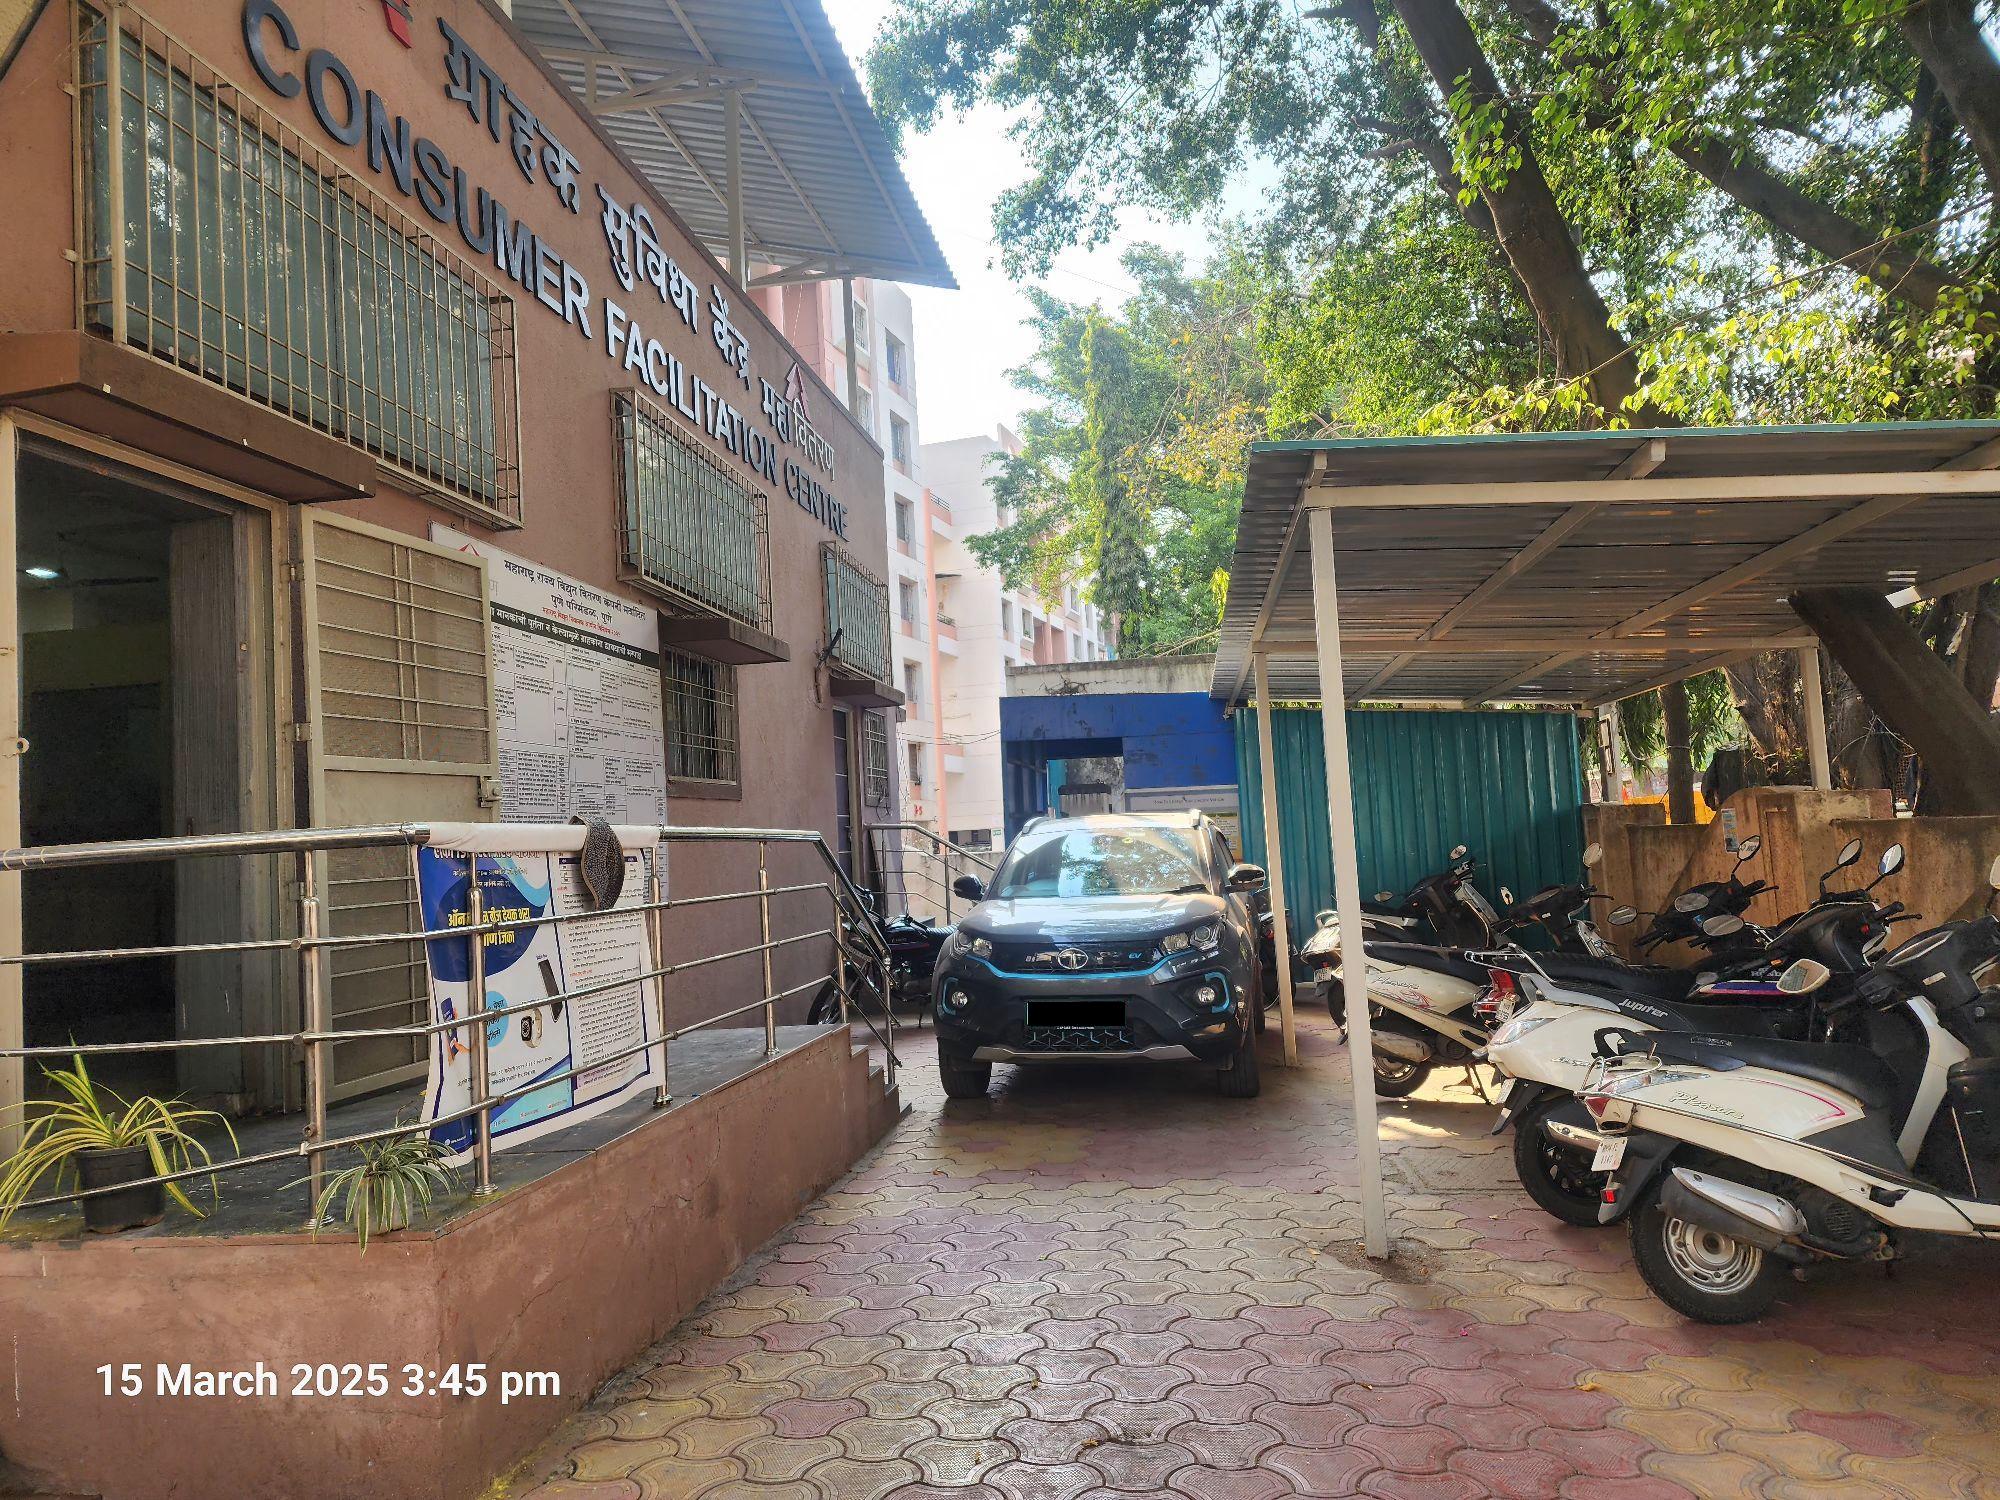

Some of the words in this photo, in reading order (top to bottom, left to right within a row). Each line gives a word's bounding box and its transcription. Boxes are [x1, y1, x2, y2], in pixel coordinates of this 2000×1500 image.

[437, 17, 580, 214] ग्राहक
[596, 183, 700, 333] सुविधा
[710, 283, 750, 390] केंद्र
[242, 0, 593, 340] CONSUMER
[603, 297, 779, 487] FACILITATION
[783, 457, 850, 541] CENTRE
[504, 560, 537, 584] महाराष्ट्र
[537, 572, 555, 587] राज्य
[557, 577, 577, 598] विद्युत
[579, 585, 602, 604] वितरण
[551, 594, 564, 608] पुणे
[601, 612, 613, 624] पुणे
[1618, 998, 1669, 1018] Jupiter
[1669, 1089, 1745, 1120] Pleasure
